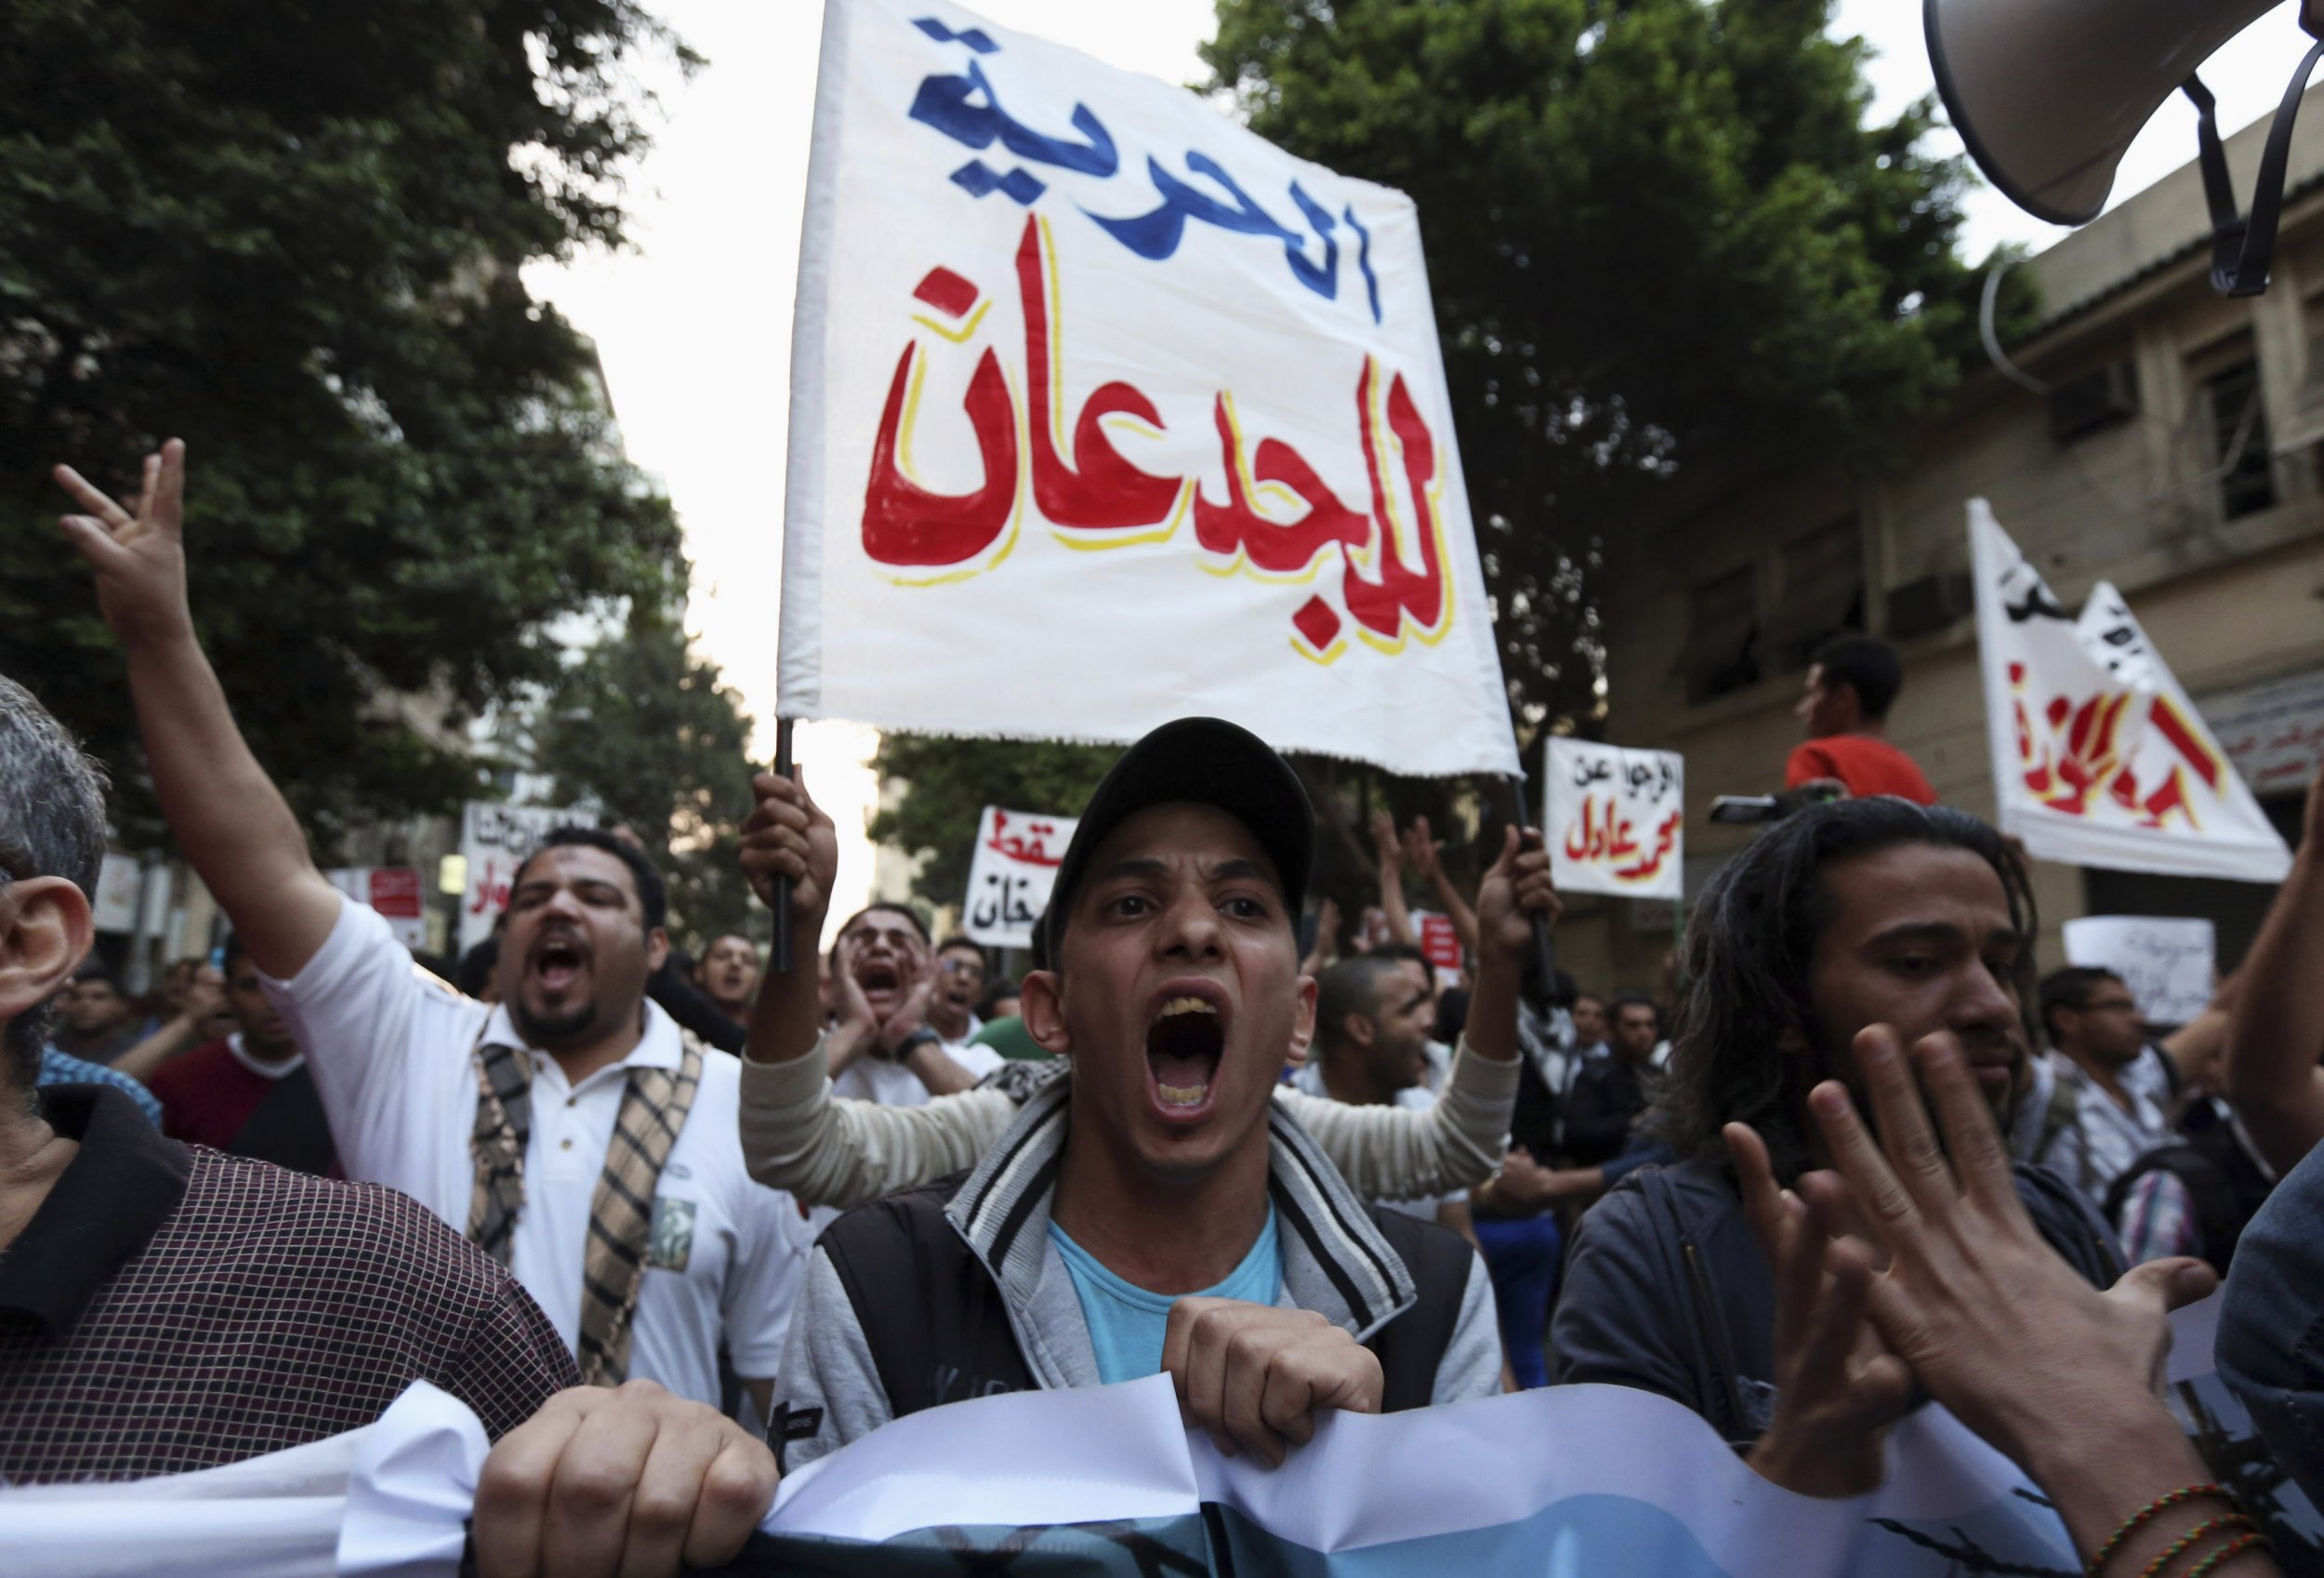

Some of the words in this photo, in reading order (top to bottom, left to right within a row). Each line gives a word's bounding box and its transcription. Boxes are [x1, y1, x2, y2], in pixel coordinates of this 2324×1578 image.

[908, 18, 1381, 325] الحرية
[861, 211, 1452, 665] للجدعان
[1575, 754, 1612, 787] عن
[1565, 793, 1640, 862] عادل
[1615, 810, 1682, 883] محمد
